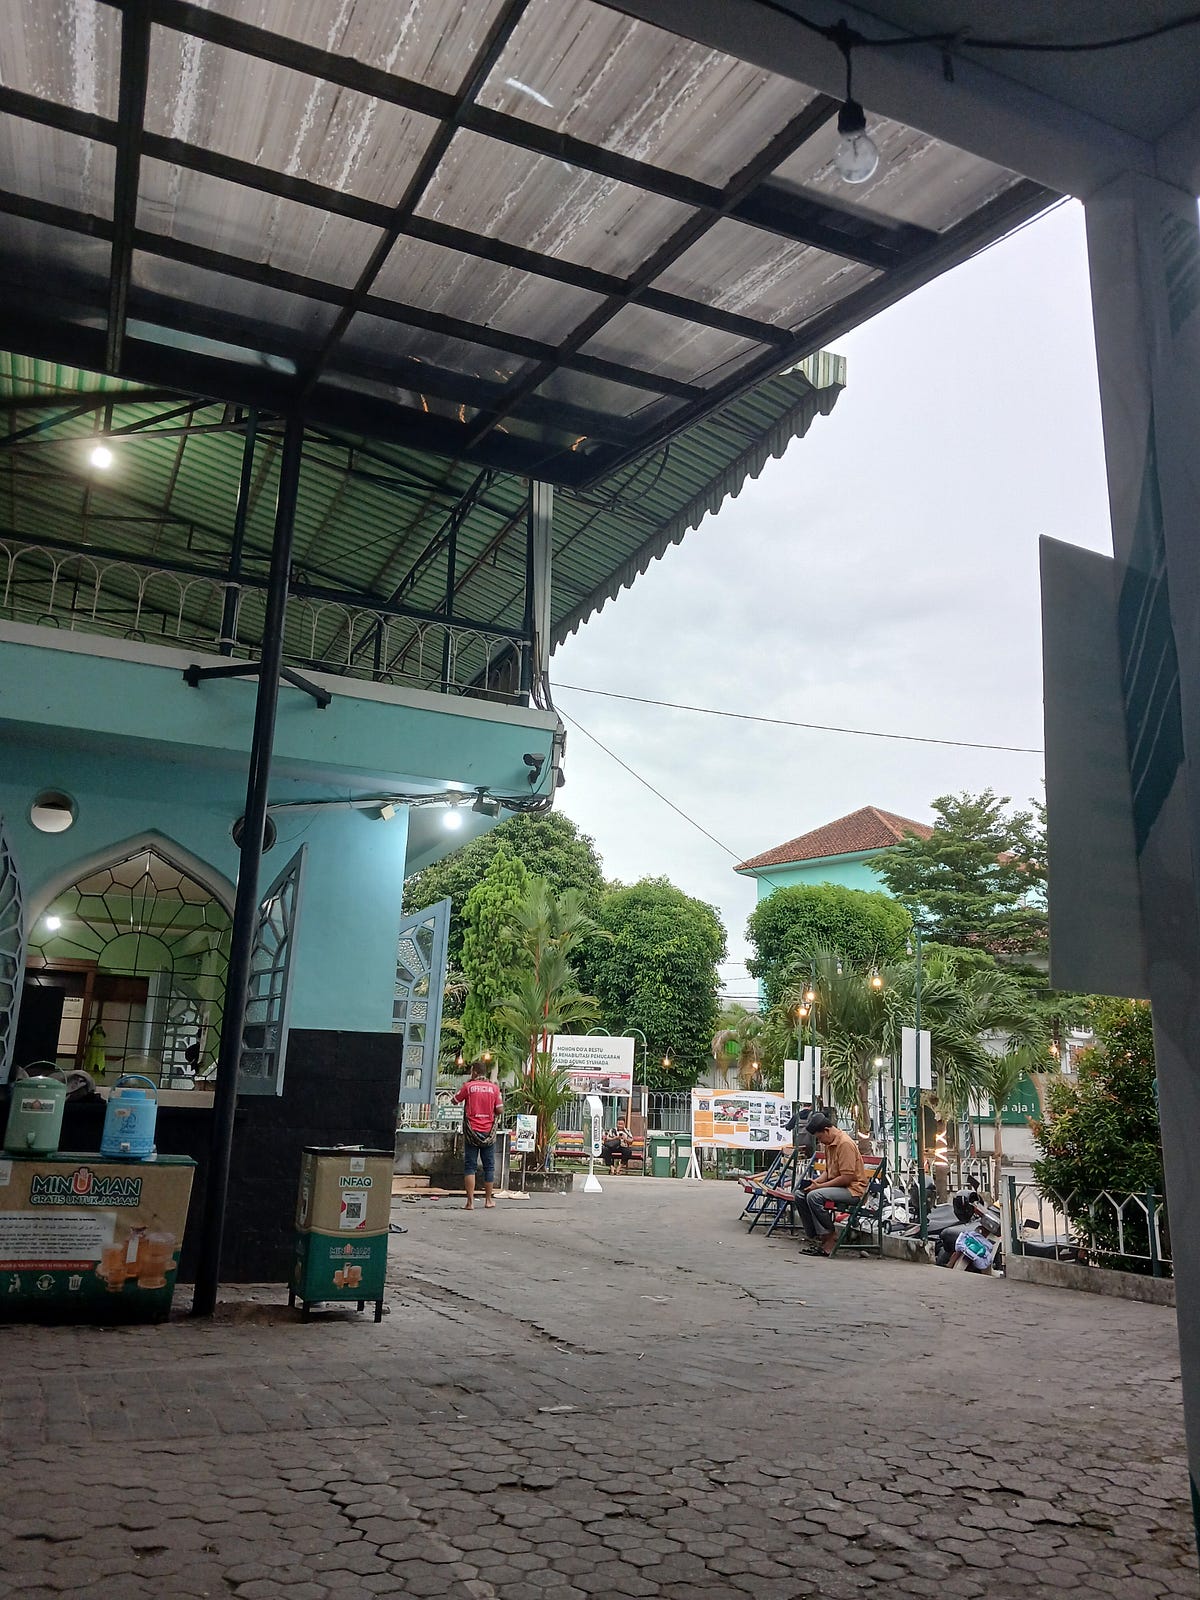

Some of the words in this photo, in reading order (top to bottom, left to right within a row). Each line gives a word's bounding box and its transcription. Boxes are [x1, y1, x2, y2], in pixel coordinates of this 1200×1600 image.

[1011, 1102, 1028, 1114] aja
[1031, 1102, 1035, 1112] !
[33, 1171, 142, 1195] MINUMAN
[339, 1176, 372, 1187] INFAQ
[31, 1194, 66, 1205] GRATIS
[66, 1195, 99, 1206] UNTUK
[99, 1196, 139, 1206] JAMAAH
